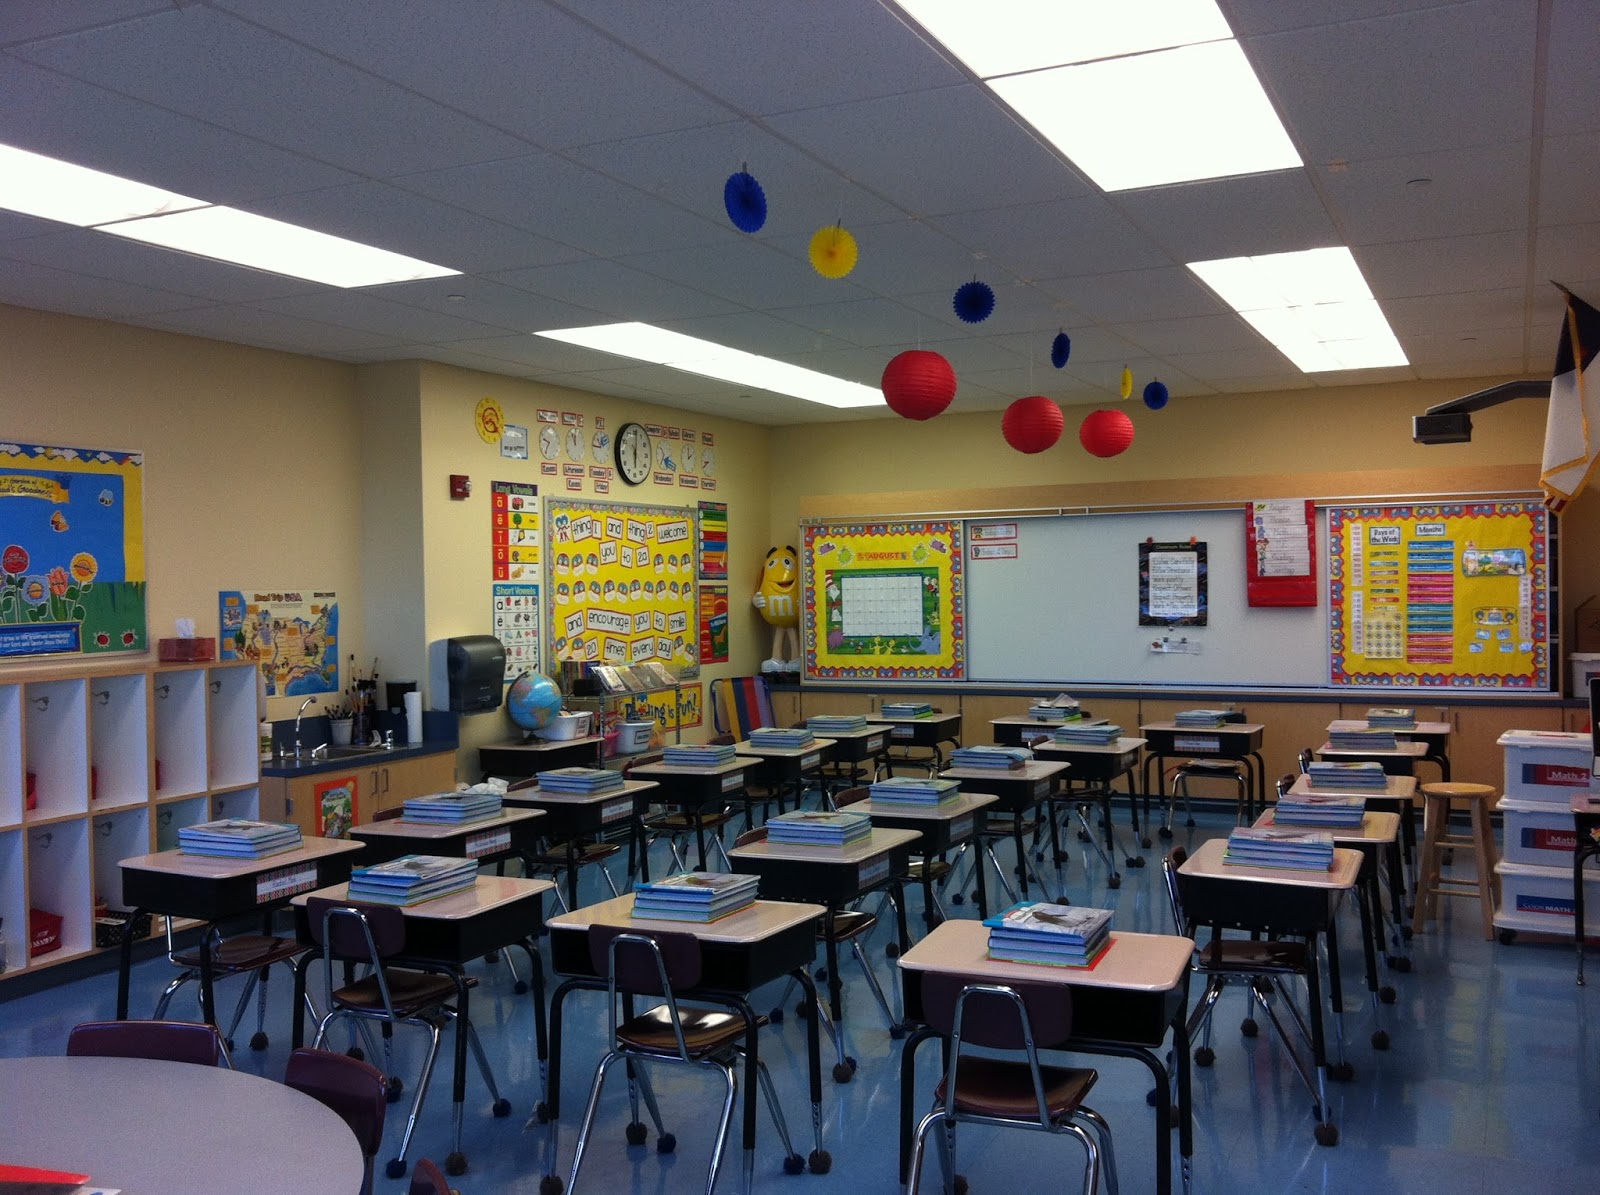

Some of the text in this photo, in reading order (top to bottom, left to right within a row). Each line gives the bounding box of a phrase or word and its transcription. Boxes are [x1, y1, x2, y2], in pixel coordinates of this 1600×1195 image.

[495, 482, 534, 497] Long Vowels
[572, 520, 592, 536] thing
[607, 521, 621, 534] and
[628, 522, 645, 542] thing
[658, 525, 687, 540] welcome
[1374, 529, 1388, 537] Days
[1418, 525, 1442, 533] Months
[601, 545, 616, 561] you
[622, 552, 631, 563] to
[868, 552, 900, 560] AUGUST
[495, 586, 537, 596] Short Vowels
[768, 594, 794, 617] m
[567, 612, 685, 632] and encourage you to smile
[586, 640, 671, 657] 20 times every day
[625, 703, 666, 726] Ring
[668, 704, 674, 719] is
[1551, 770, 1587, 780] Math 2
[1550, 835, 1577, 844] Math
[1545, 903, 1571, 913] MATH
